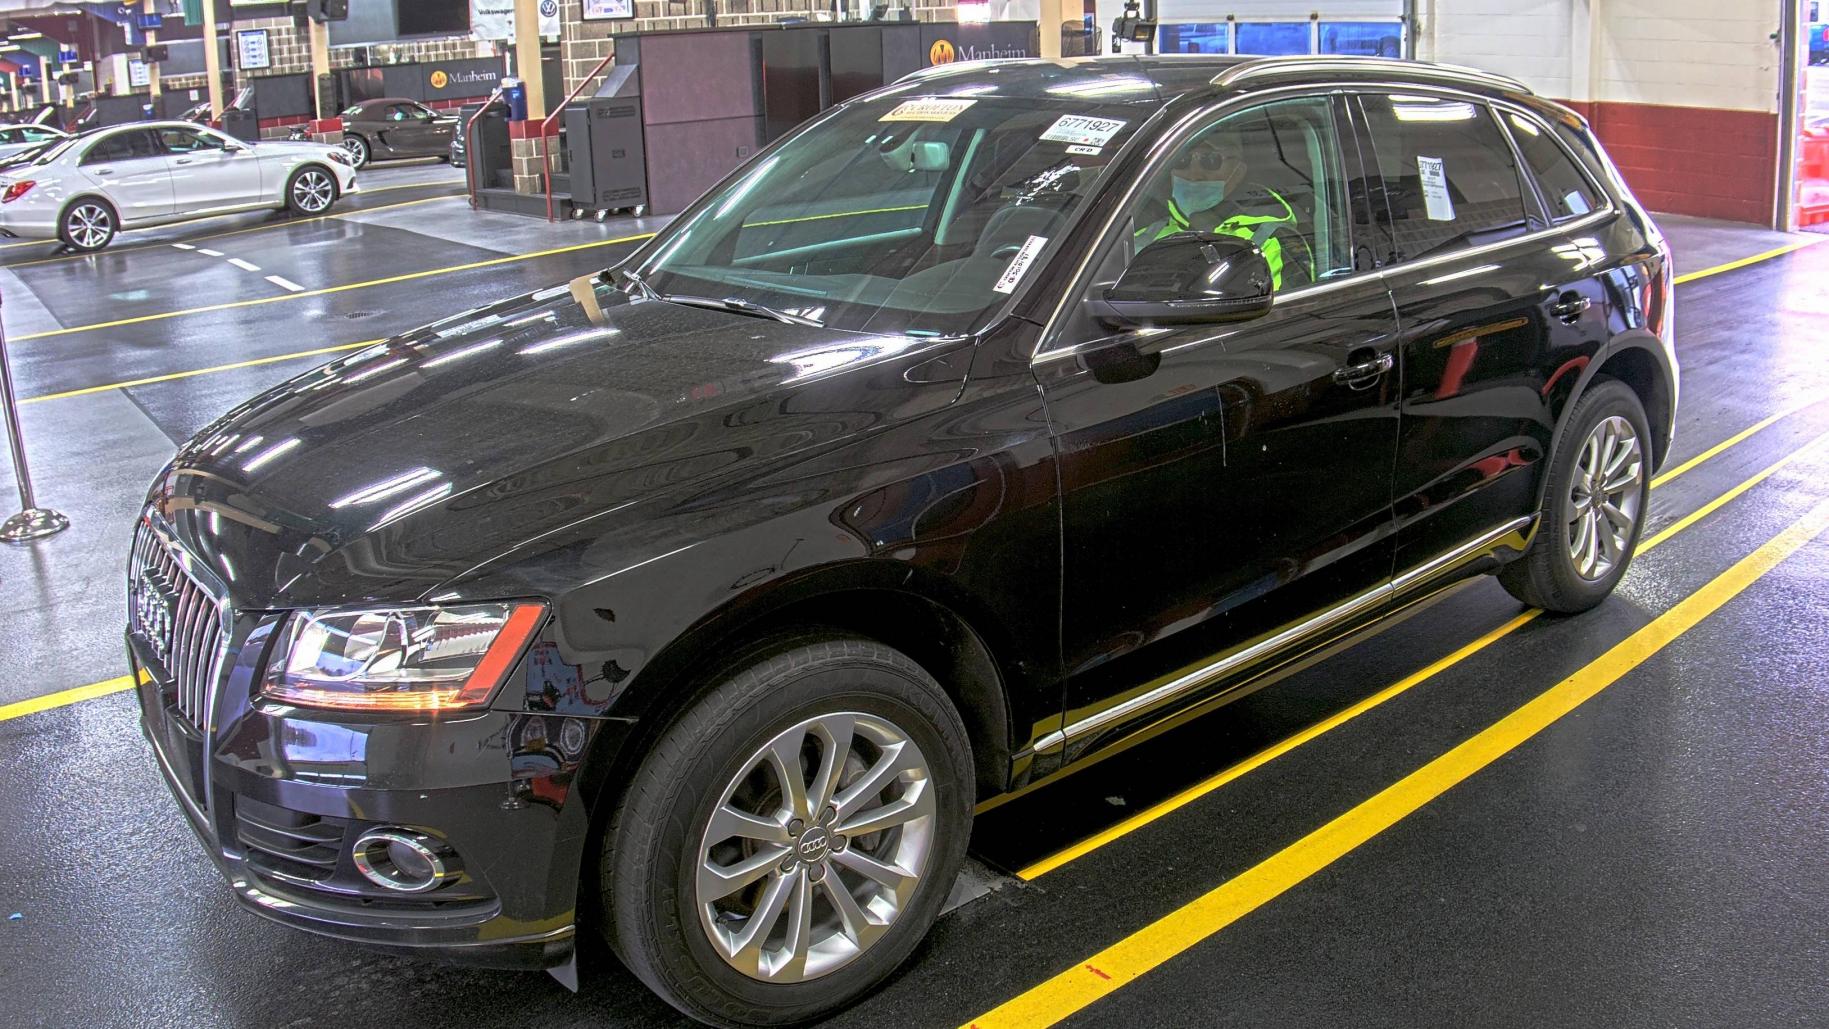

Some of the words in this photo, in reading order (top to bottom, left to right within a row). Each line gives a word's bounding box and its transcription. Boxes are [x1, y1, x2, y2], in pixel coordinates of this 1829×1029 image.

[958, 44, 1026, 60] Manheim
[449, 70, 496, 82] Manheim
[1059, 117, 1119, 132] 6771927
